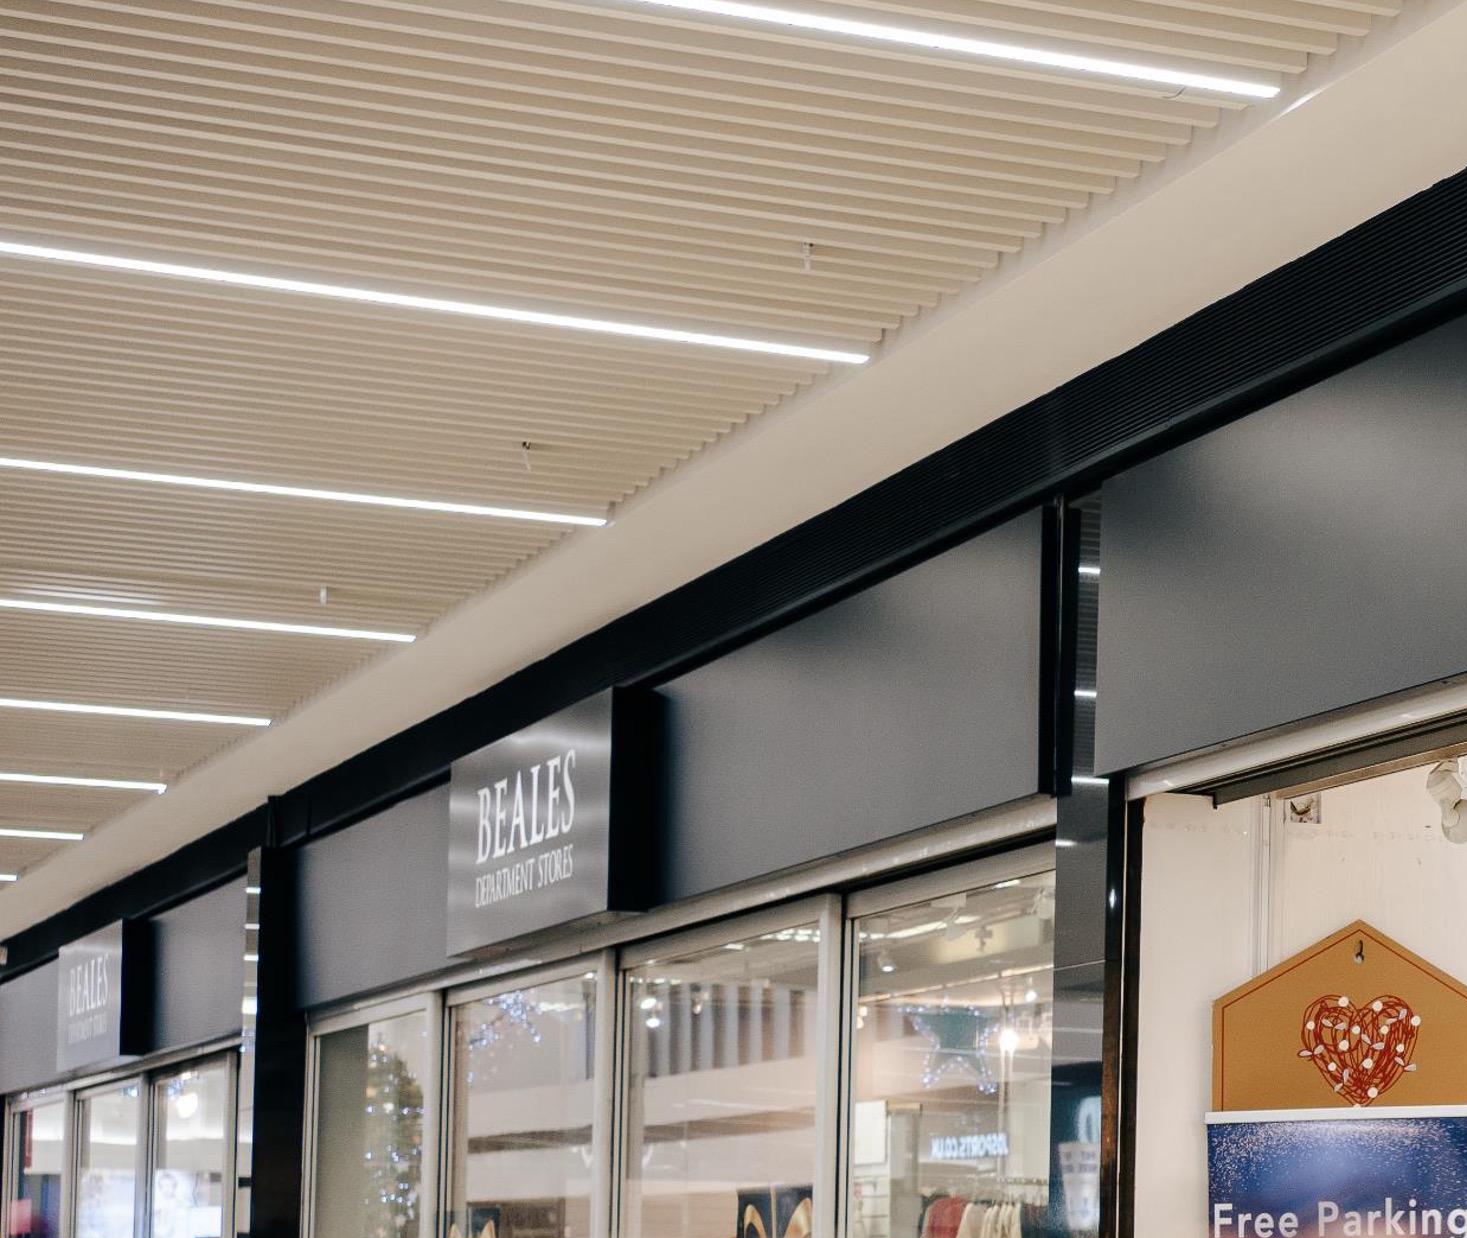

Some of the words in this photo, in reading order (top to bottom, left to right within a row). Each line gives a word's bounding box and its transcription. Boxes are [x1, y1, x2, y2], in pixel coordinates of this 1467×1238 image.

[475, 749, 576, 865] BEALES
[475, 858, 535, 908] DEPARTMENT
[537, 843, 574, 888] STORES
[69, 954, 109, 1017] BEALES
[1214, 1203, 1299, 1238] Free
